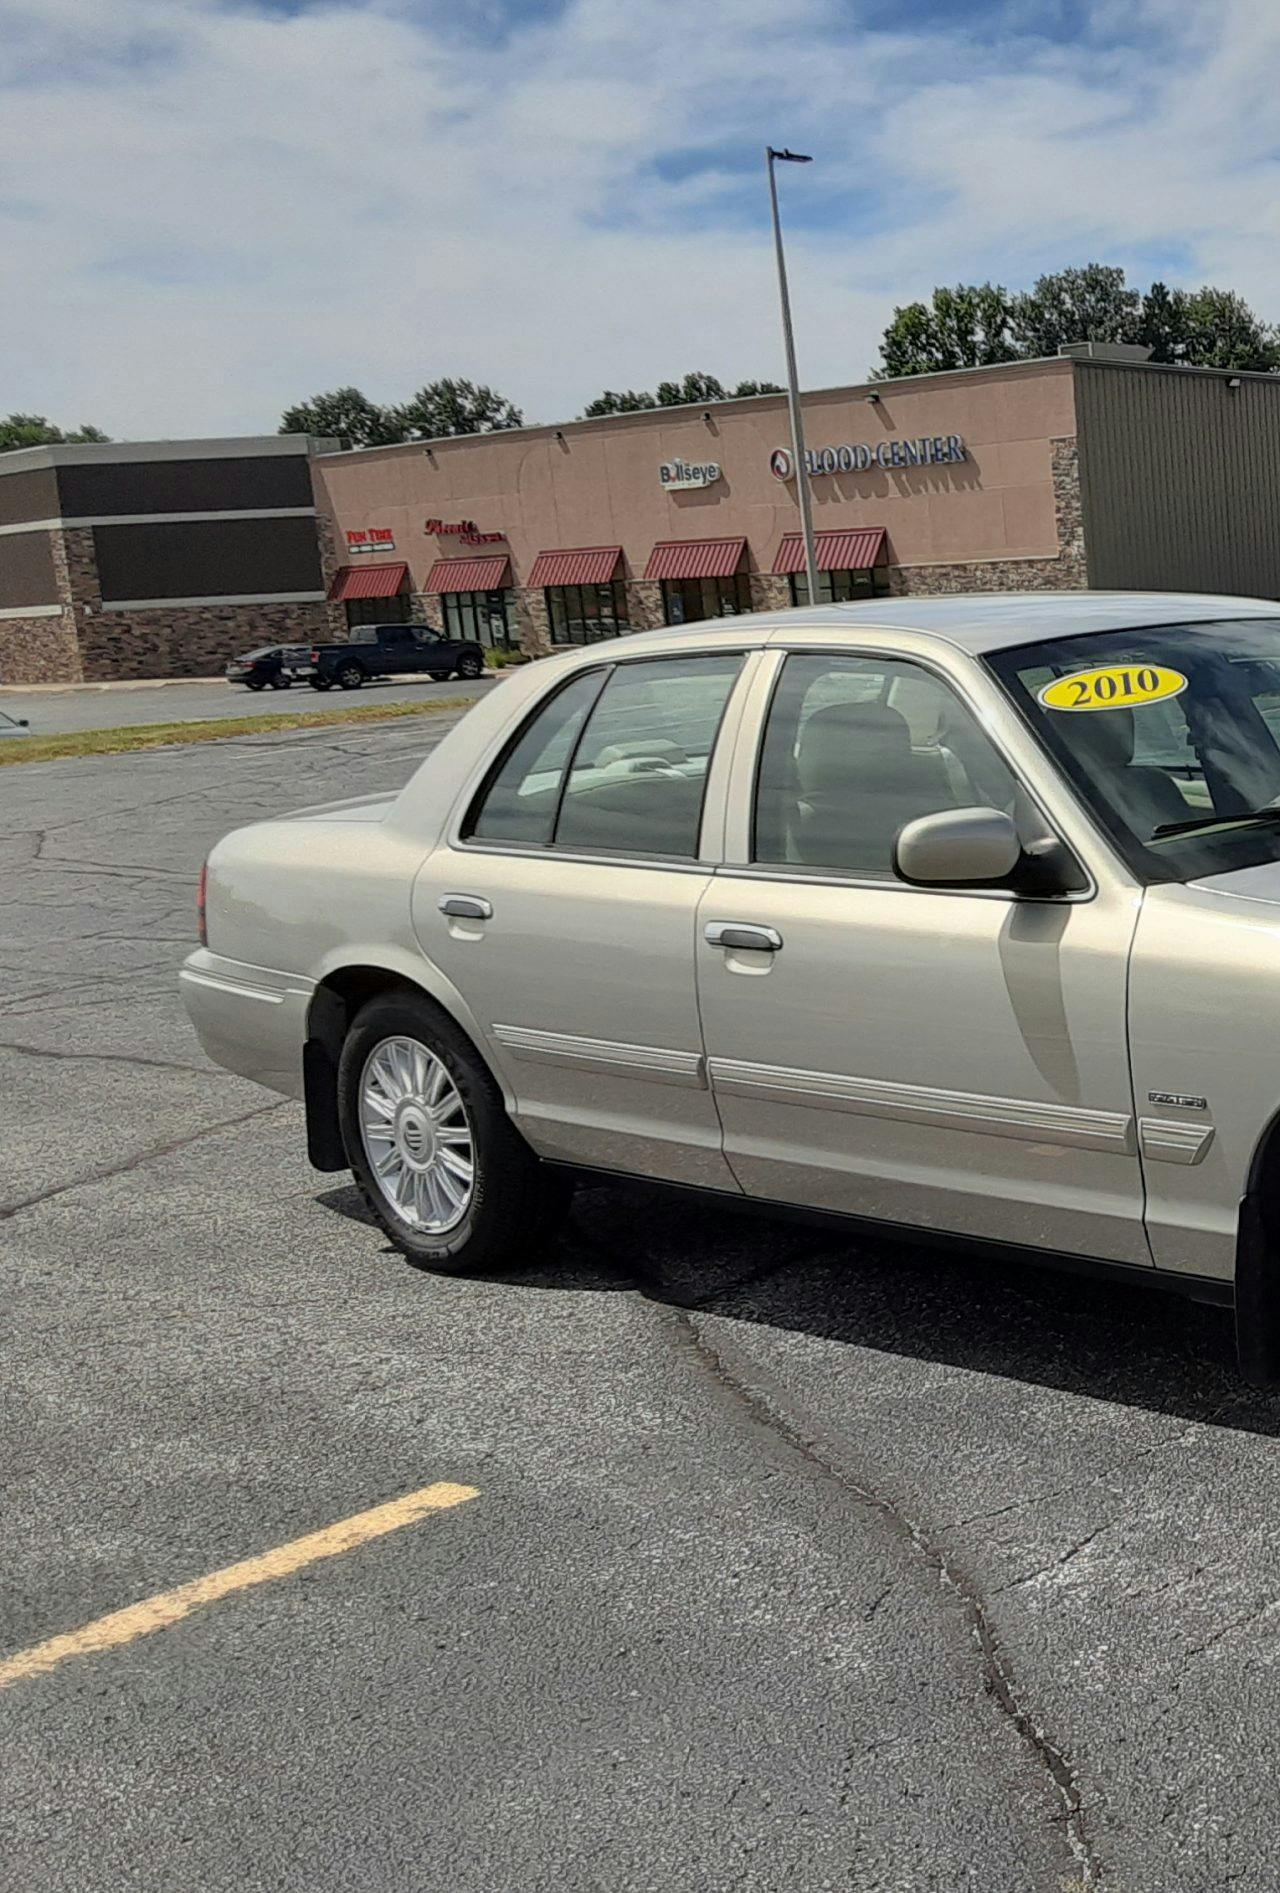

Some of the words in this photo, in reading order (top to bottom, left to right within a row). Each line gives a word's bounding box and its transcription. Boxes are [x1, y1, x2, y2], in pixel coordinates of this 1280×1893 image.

[803, 445, 872, 475] LOOD
[876, 434, 966, 469] CENTER
[1067, 668, 1160, 706] 2010
